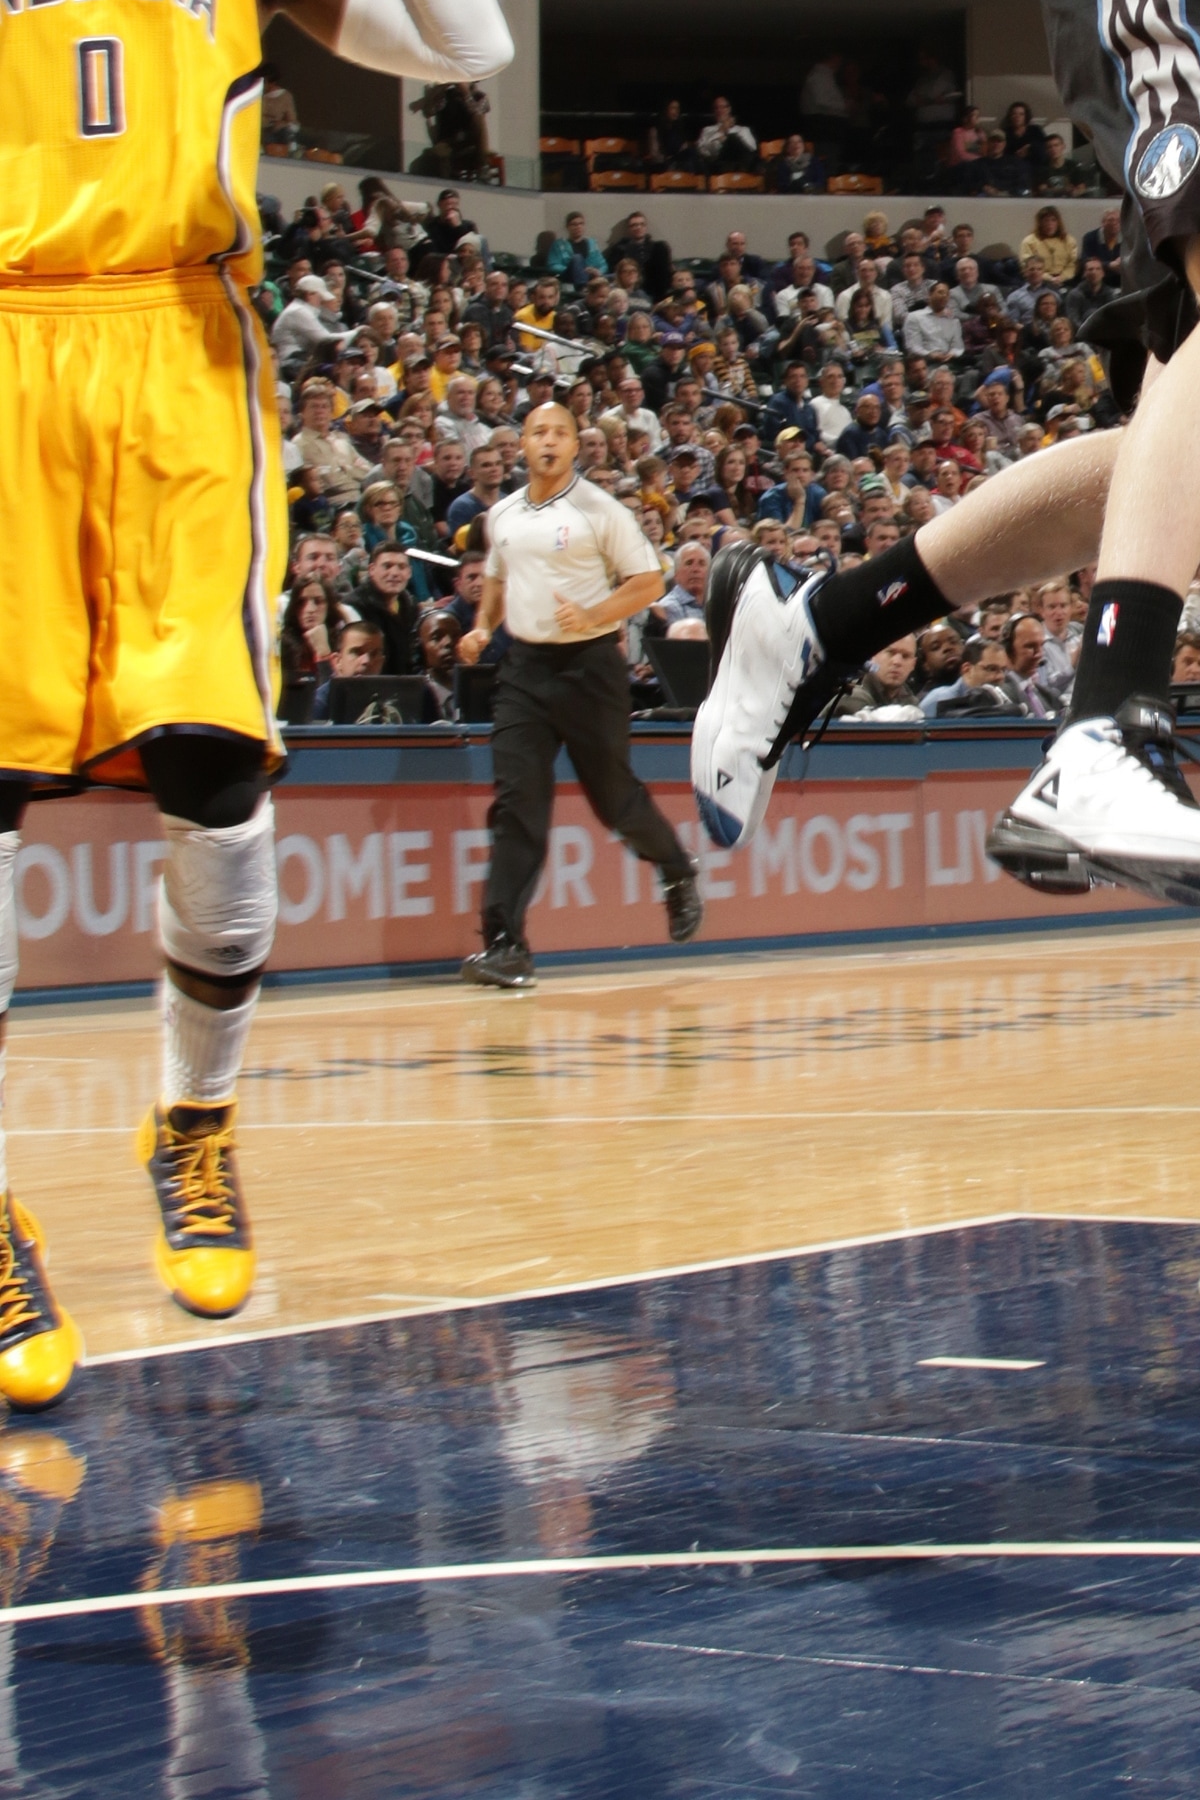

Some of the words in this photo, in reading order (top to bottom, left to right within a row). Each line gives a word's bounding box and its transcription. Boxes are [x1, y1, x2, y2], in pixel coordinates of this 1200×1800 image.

[77, 37, 127, 139] 0
[275, 830, 435, 926] OME
[452, 824, 597, 916] FR
[608, 821, 737, 906] TE
[750, 812, 913, 898] MOST
[925, 809, 1006, 888] LIV
